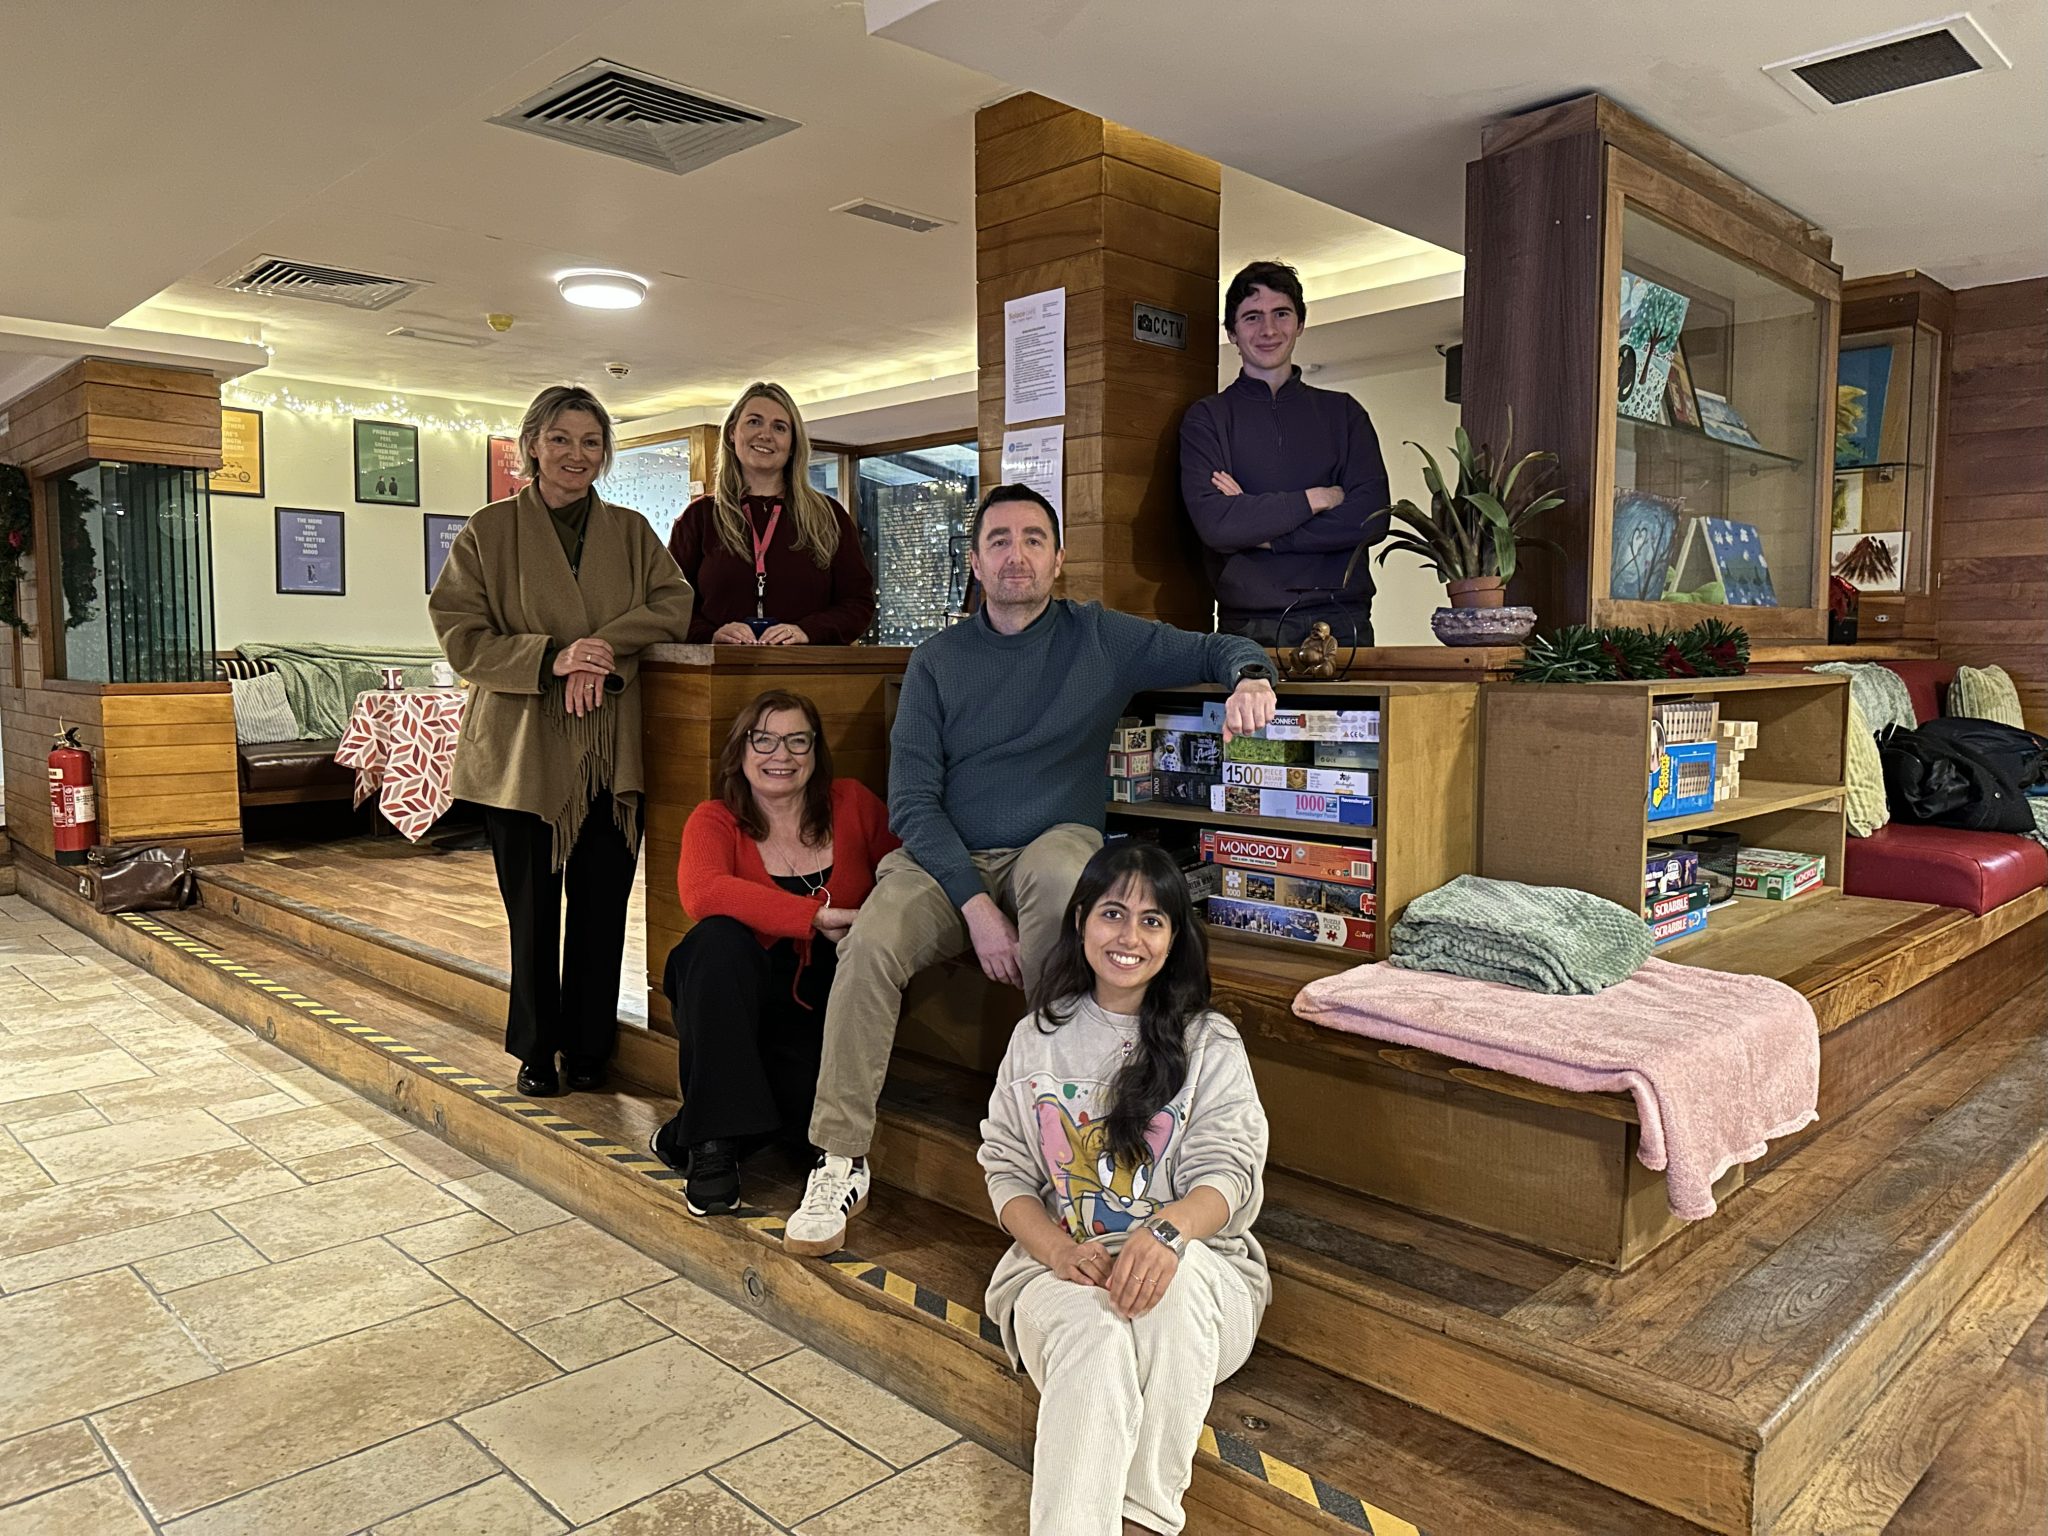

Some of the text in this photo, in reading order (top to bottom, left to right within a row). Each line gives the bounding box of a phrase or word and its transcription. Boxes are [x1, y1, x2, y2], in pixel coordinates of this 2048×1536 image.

[1153, 316, 1183, 339] CCTV
[1270, 717, 1299, 725] CONNECT
[1226, 764, 1263, 786] 1500
[1264, 768, 1283, 777] PIECE
[1295, 794, 1325, 812] 1000
[1340, 797, 1370, 806] Ravensburger
[1220, 840, 1289, 860] MONOPOLY
[1735, 877, 1756, 888] OLY
[1226, 888, 1241, 897] 1000
[1655, 896, 1689, 918] SCRABBLE
[1323, 917, 1341, 926] PUZZLE
[1654, 917, 1687, 940] SCRABBLE
